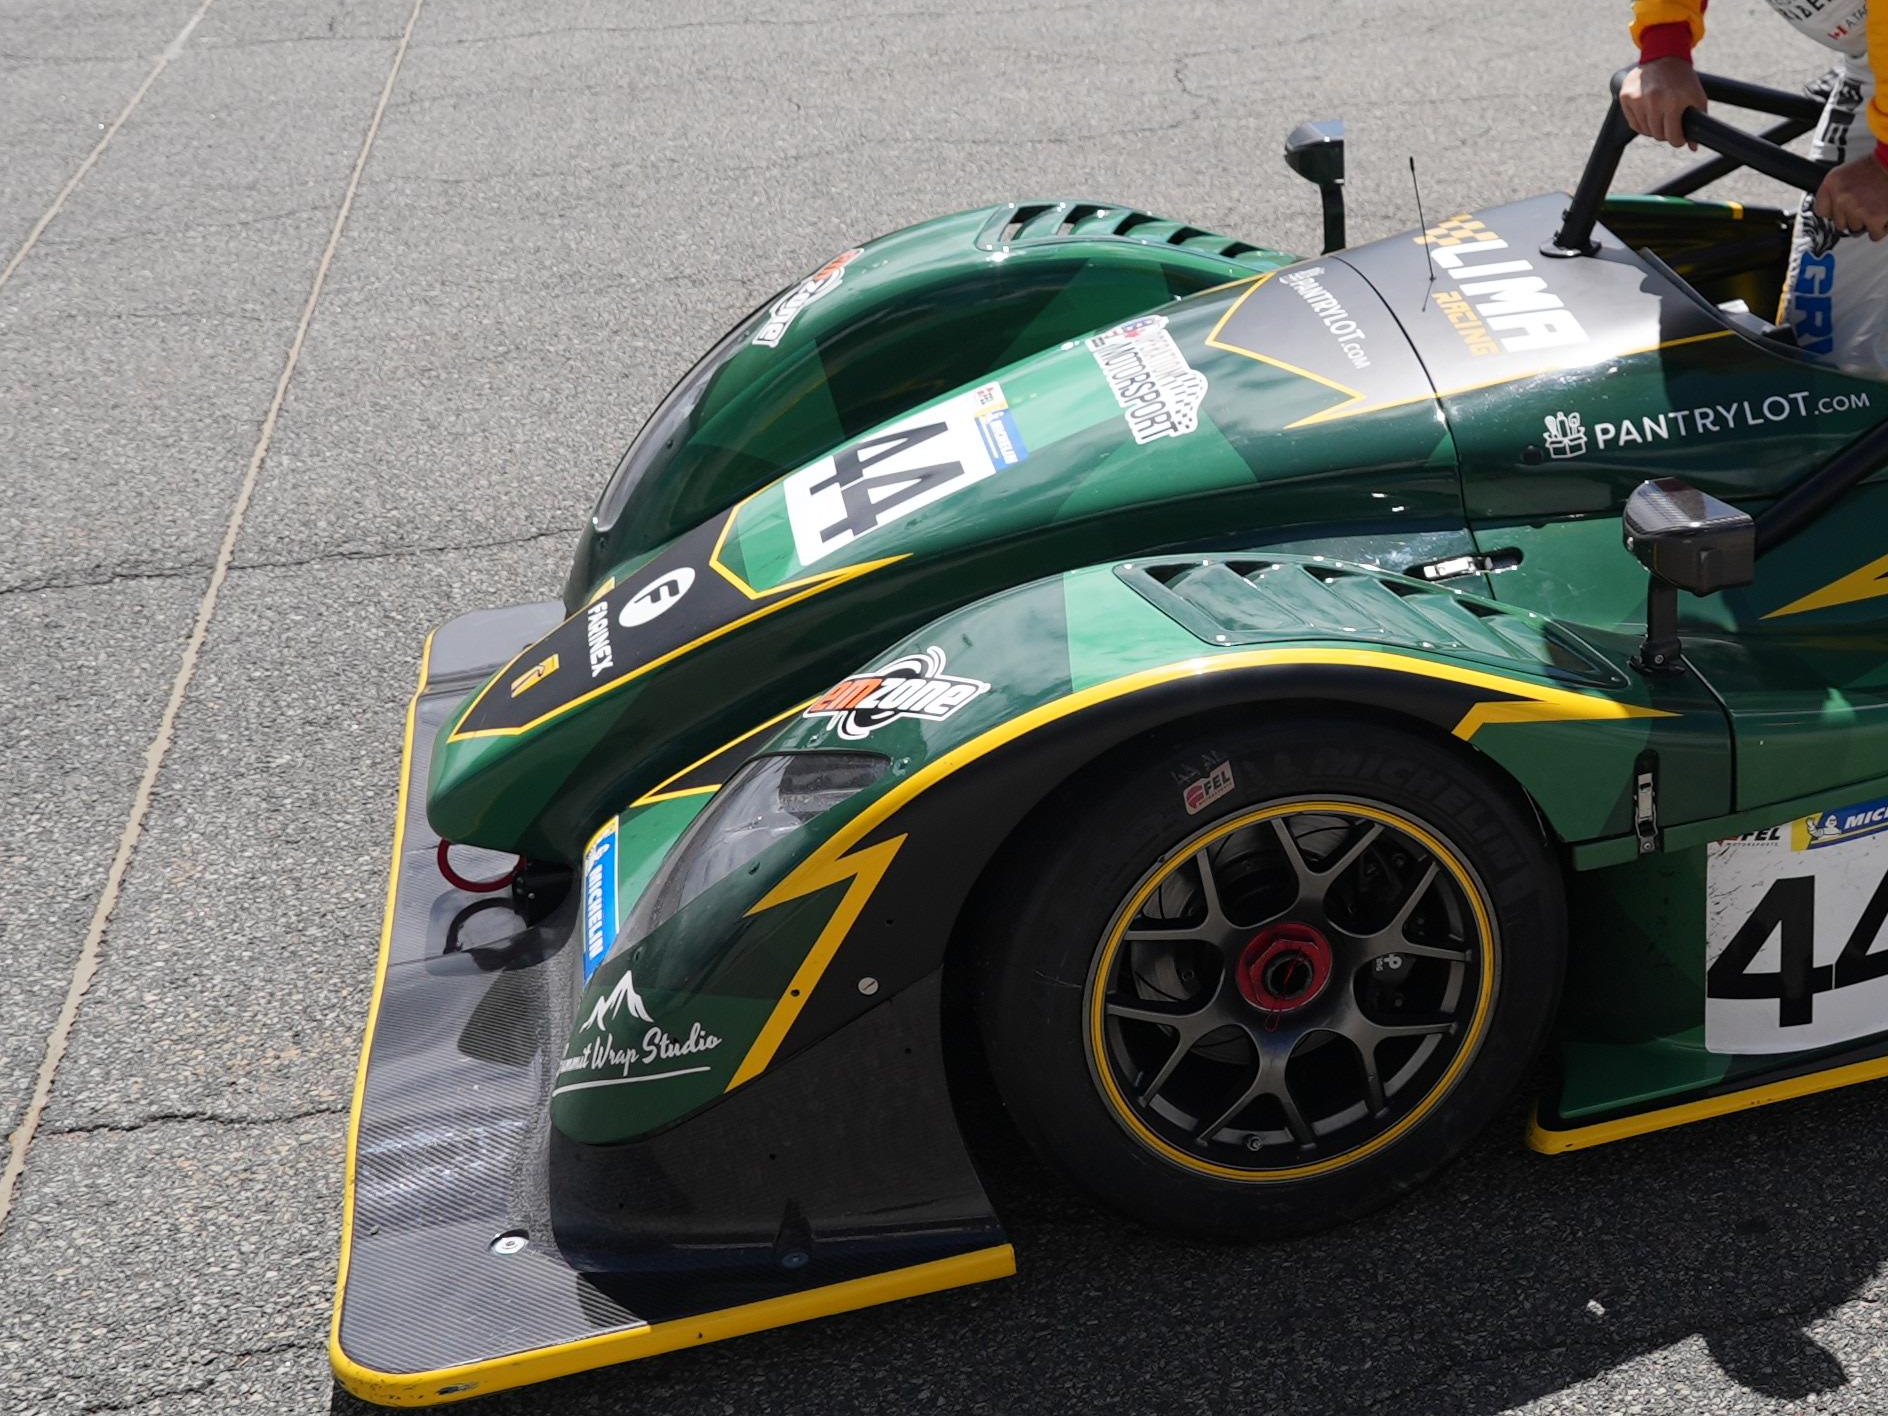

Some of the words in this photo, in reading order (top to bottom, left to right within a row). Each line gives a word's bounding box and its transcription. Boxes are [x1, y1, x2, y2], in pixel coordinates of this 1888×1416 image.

[1430, 238, 1591, 353] LIMA
[1431, 290, 1502, 357] RACING
[809, 421, 965, 543] 44
[587, 600, 614, 678] FARINEX
[811, 678, 979, 715] emzone
[1203, 770, 1231, 796] FEL
[588, 863, 604, 961] MICHELIN
[556, 1042, 592, 1074] ummit
[591, 1033, 638, 1077] Wrap
[642, 1022, 722, 1064] Studio
